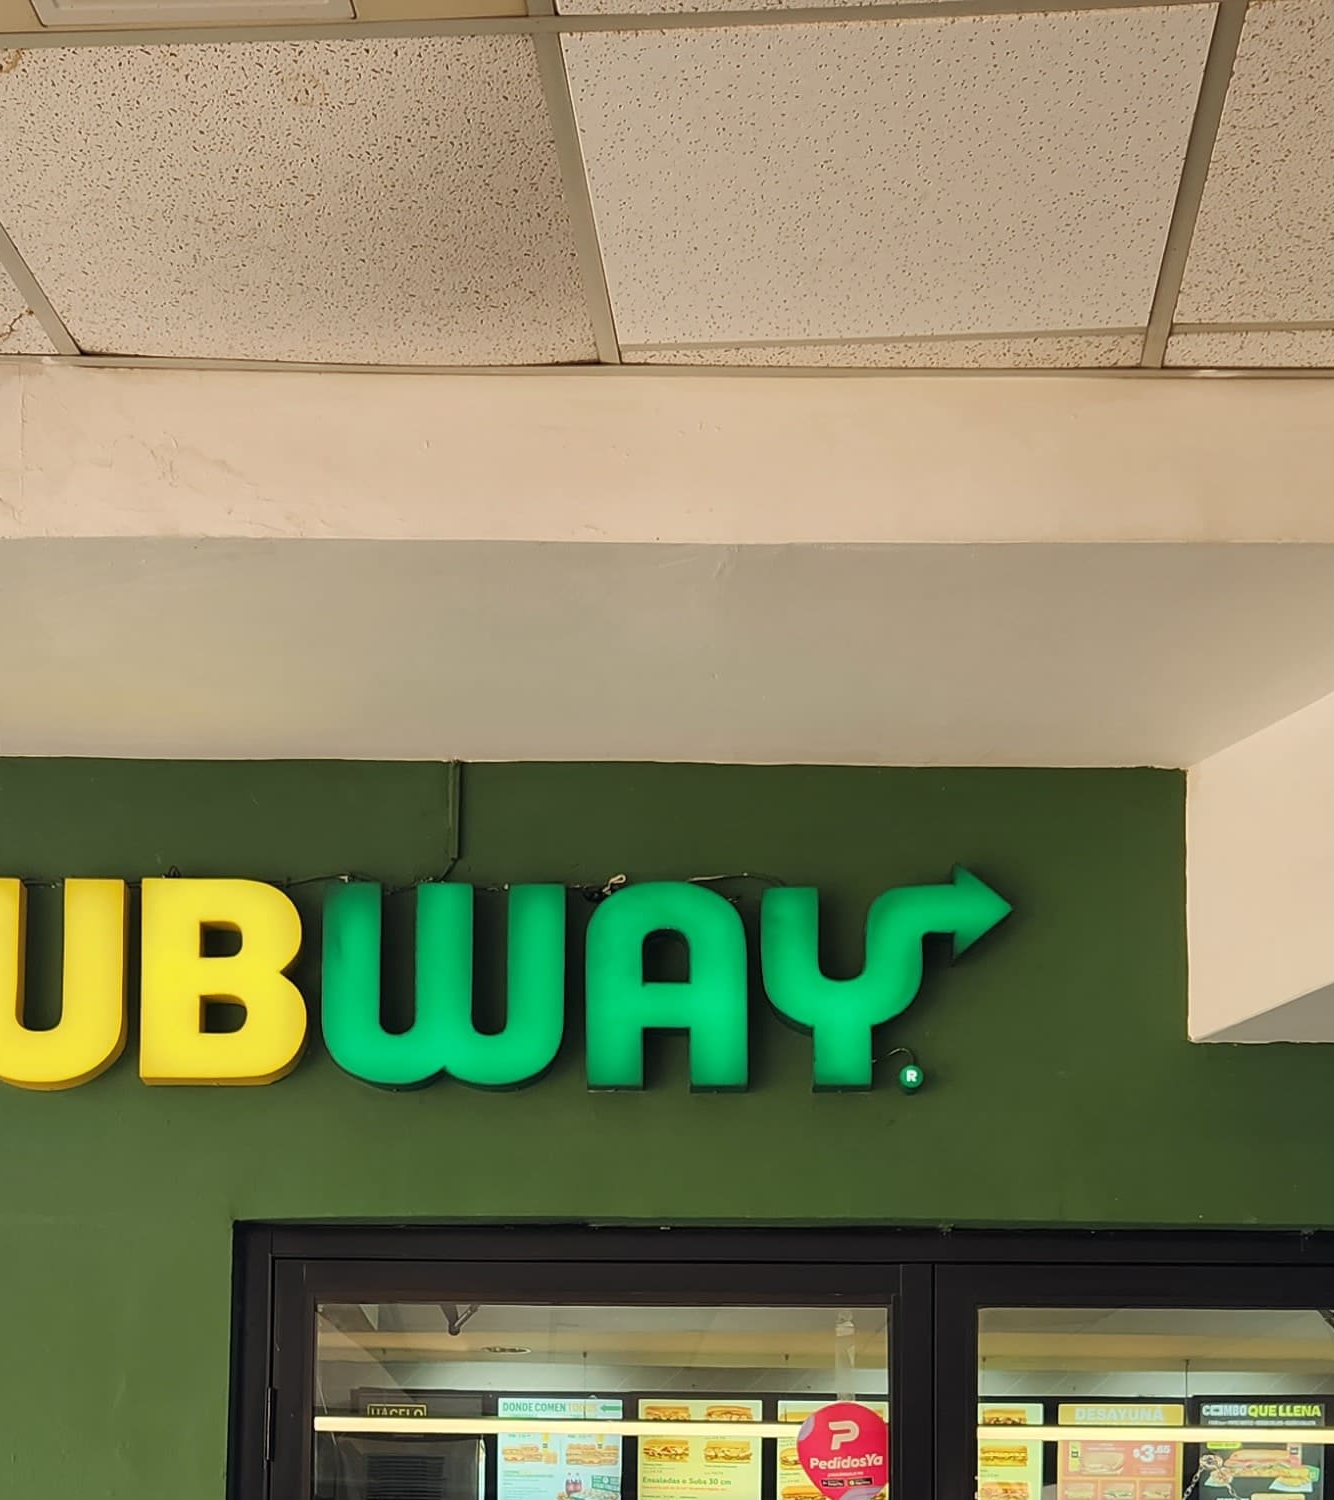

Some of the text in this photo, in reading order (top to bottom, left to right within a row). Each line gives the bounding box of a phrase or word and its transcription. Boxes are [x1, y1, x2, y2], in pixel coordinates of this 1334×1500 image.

[502, 1402, 533, 1412] DONDE
[537, 1402, 566, 1412] COMEN
[1248, 1405, 1277, 1417] QUE
[1278, 1405, 1321, 1416] LLENA
[809, 1453, 884, 1469] PedidosYa
